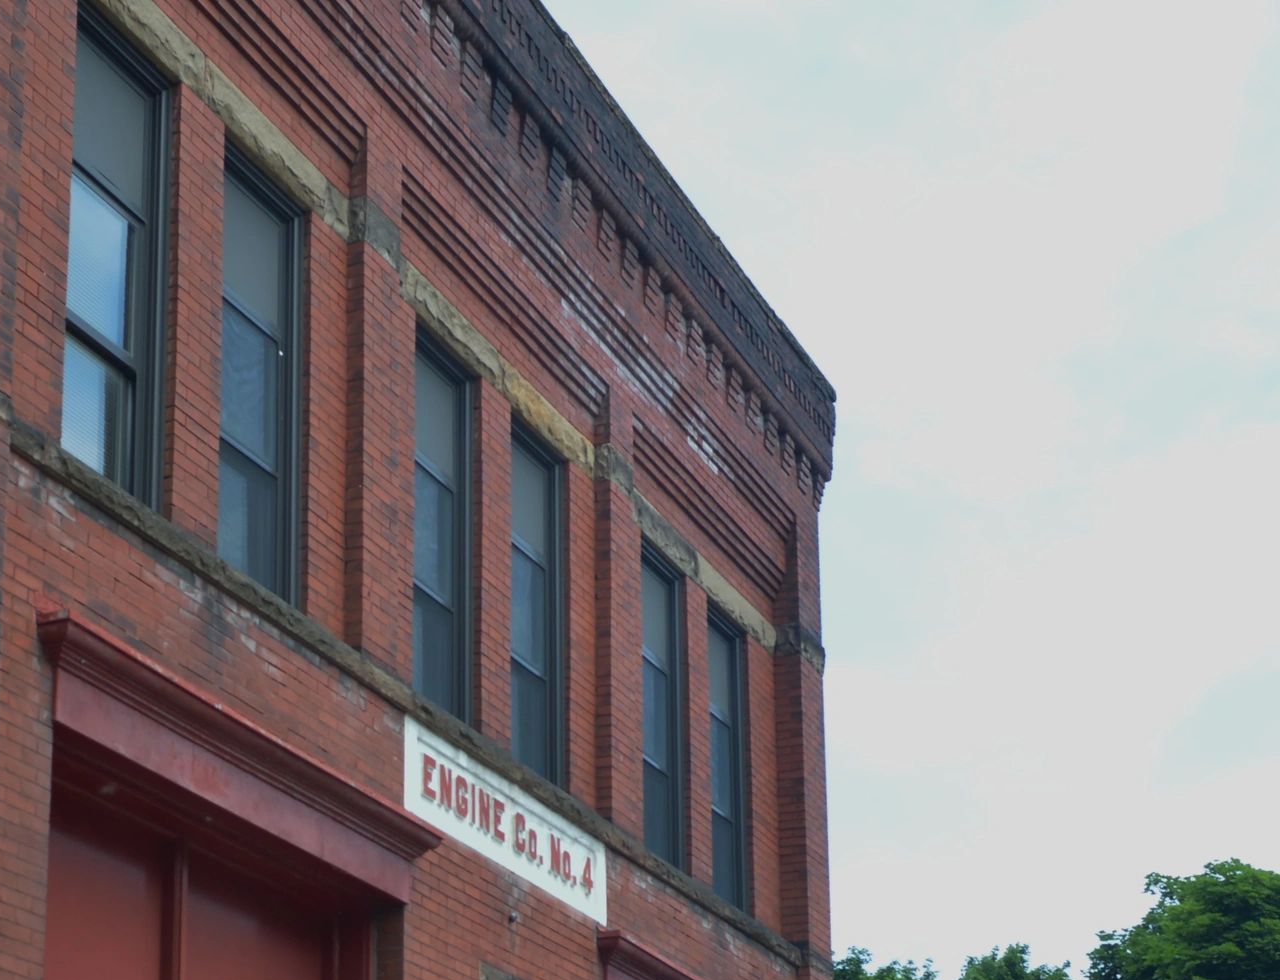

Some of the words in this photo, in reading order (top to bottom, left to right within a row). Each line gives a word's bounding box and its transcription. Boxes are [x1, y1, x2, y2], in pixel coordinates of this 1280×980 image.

[422, 753, 505, 843] ENGINE
[549, 833, 577, 887] No.
[581, 857, 593, 894] 4
